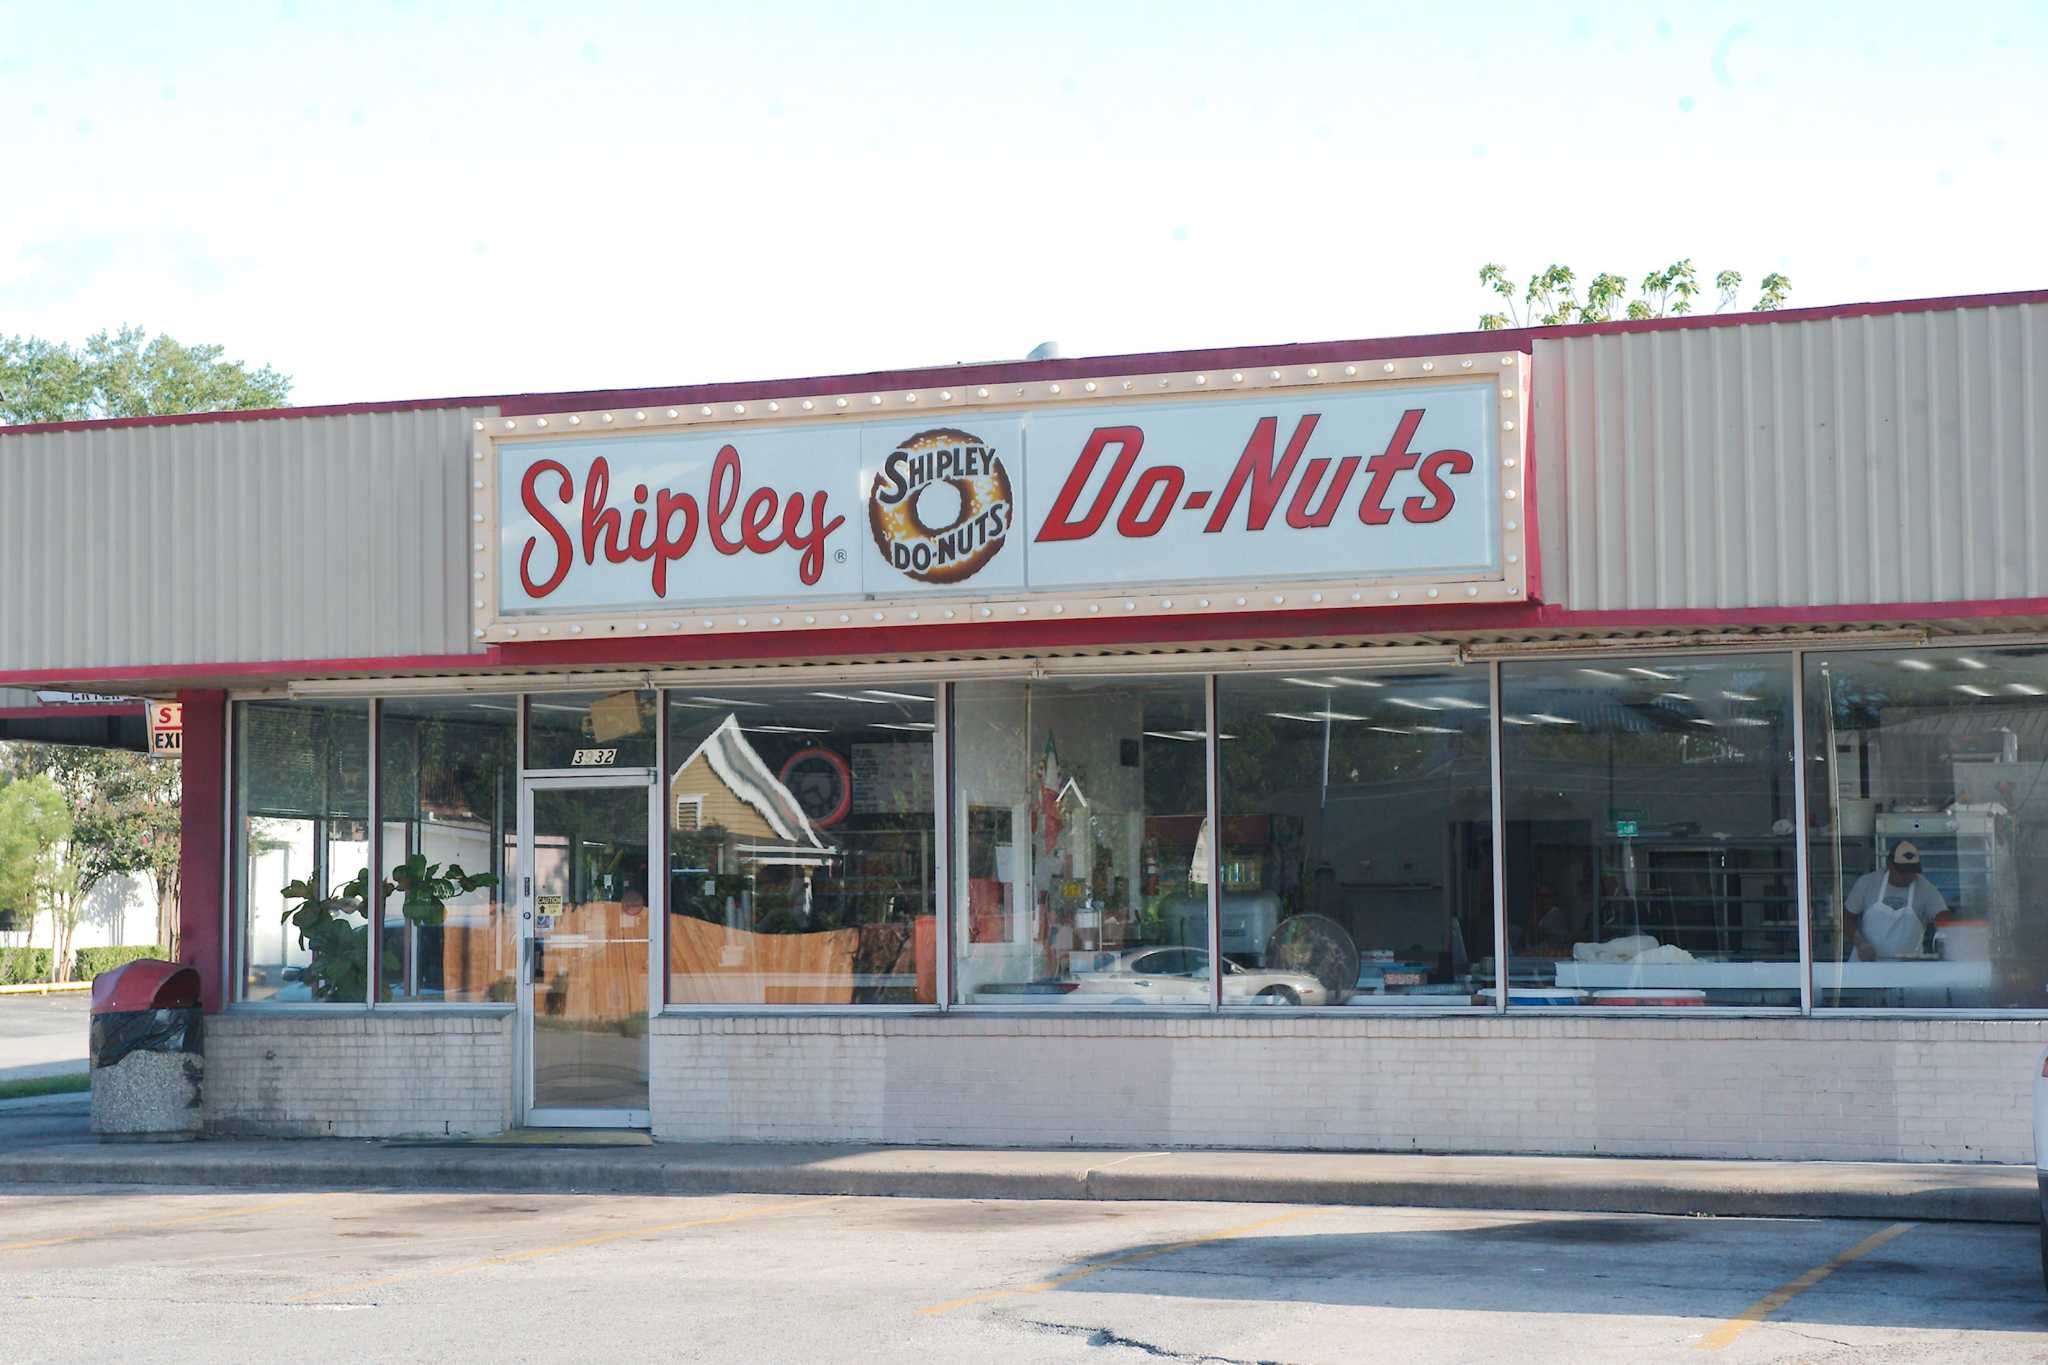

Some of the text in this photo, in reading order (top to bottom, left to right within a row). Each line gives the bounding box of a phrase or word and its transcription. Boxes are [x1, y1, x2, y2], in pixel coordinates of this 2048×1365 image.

[520, 443, 846, 599] Shipley
[1033, 408, 1474, 543] Do-Nuts
[879, 447, 996, 504] SHIPLEY
[894, 503, 1004, 571] DO-NUTS
